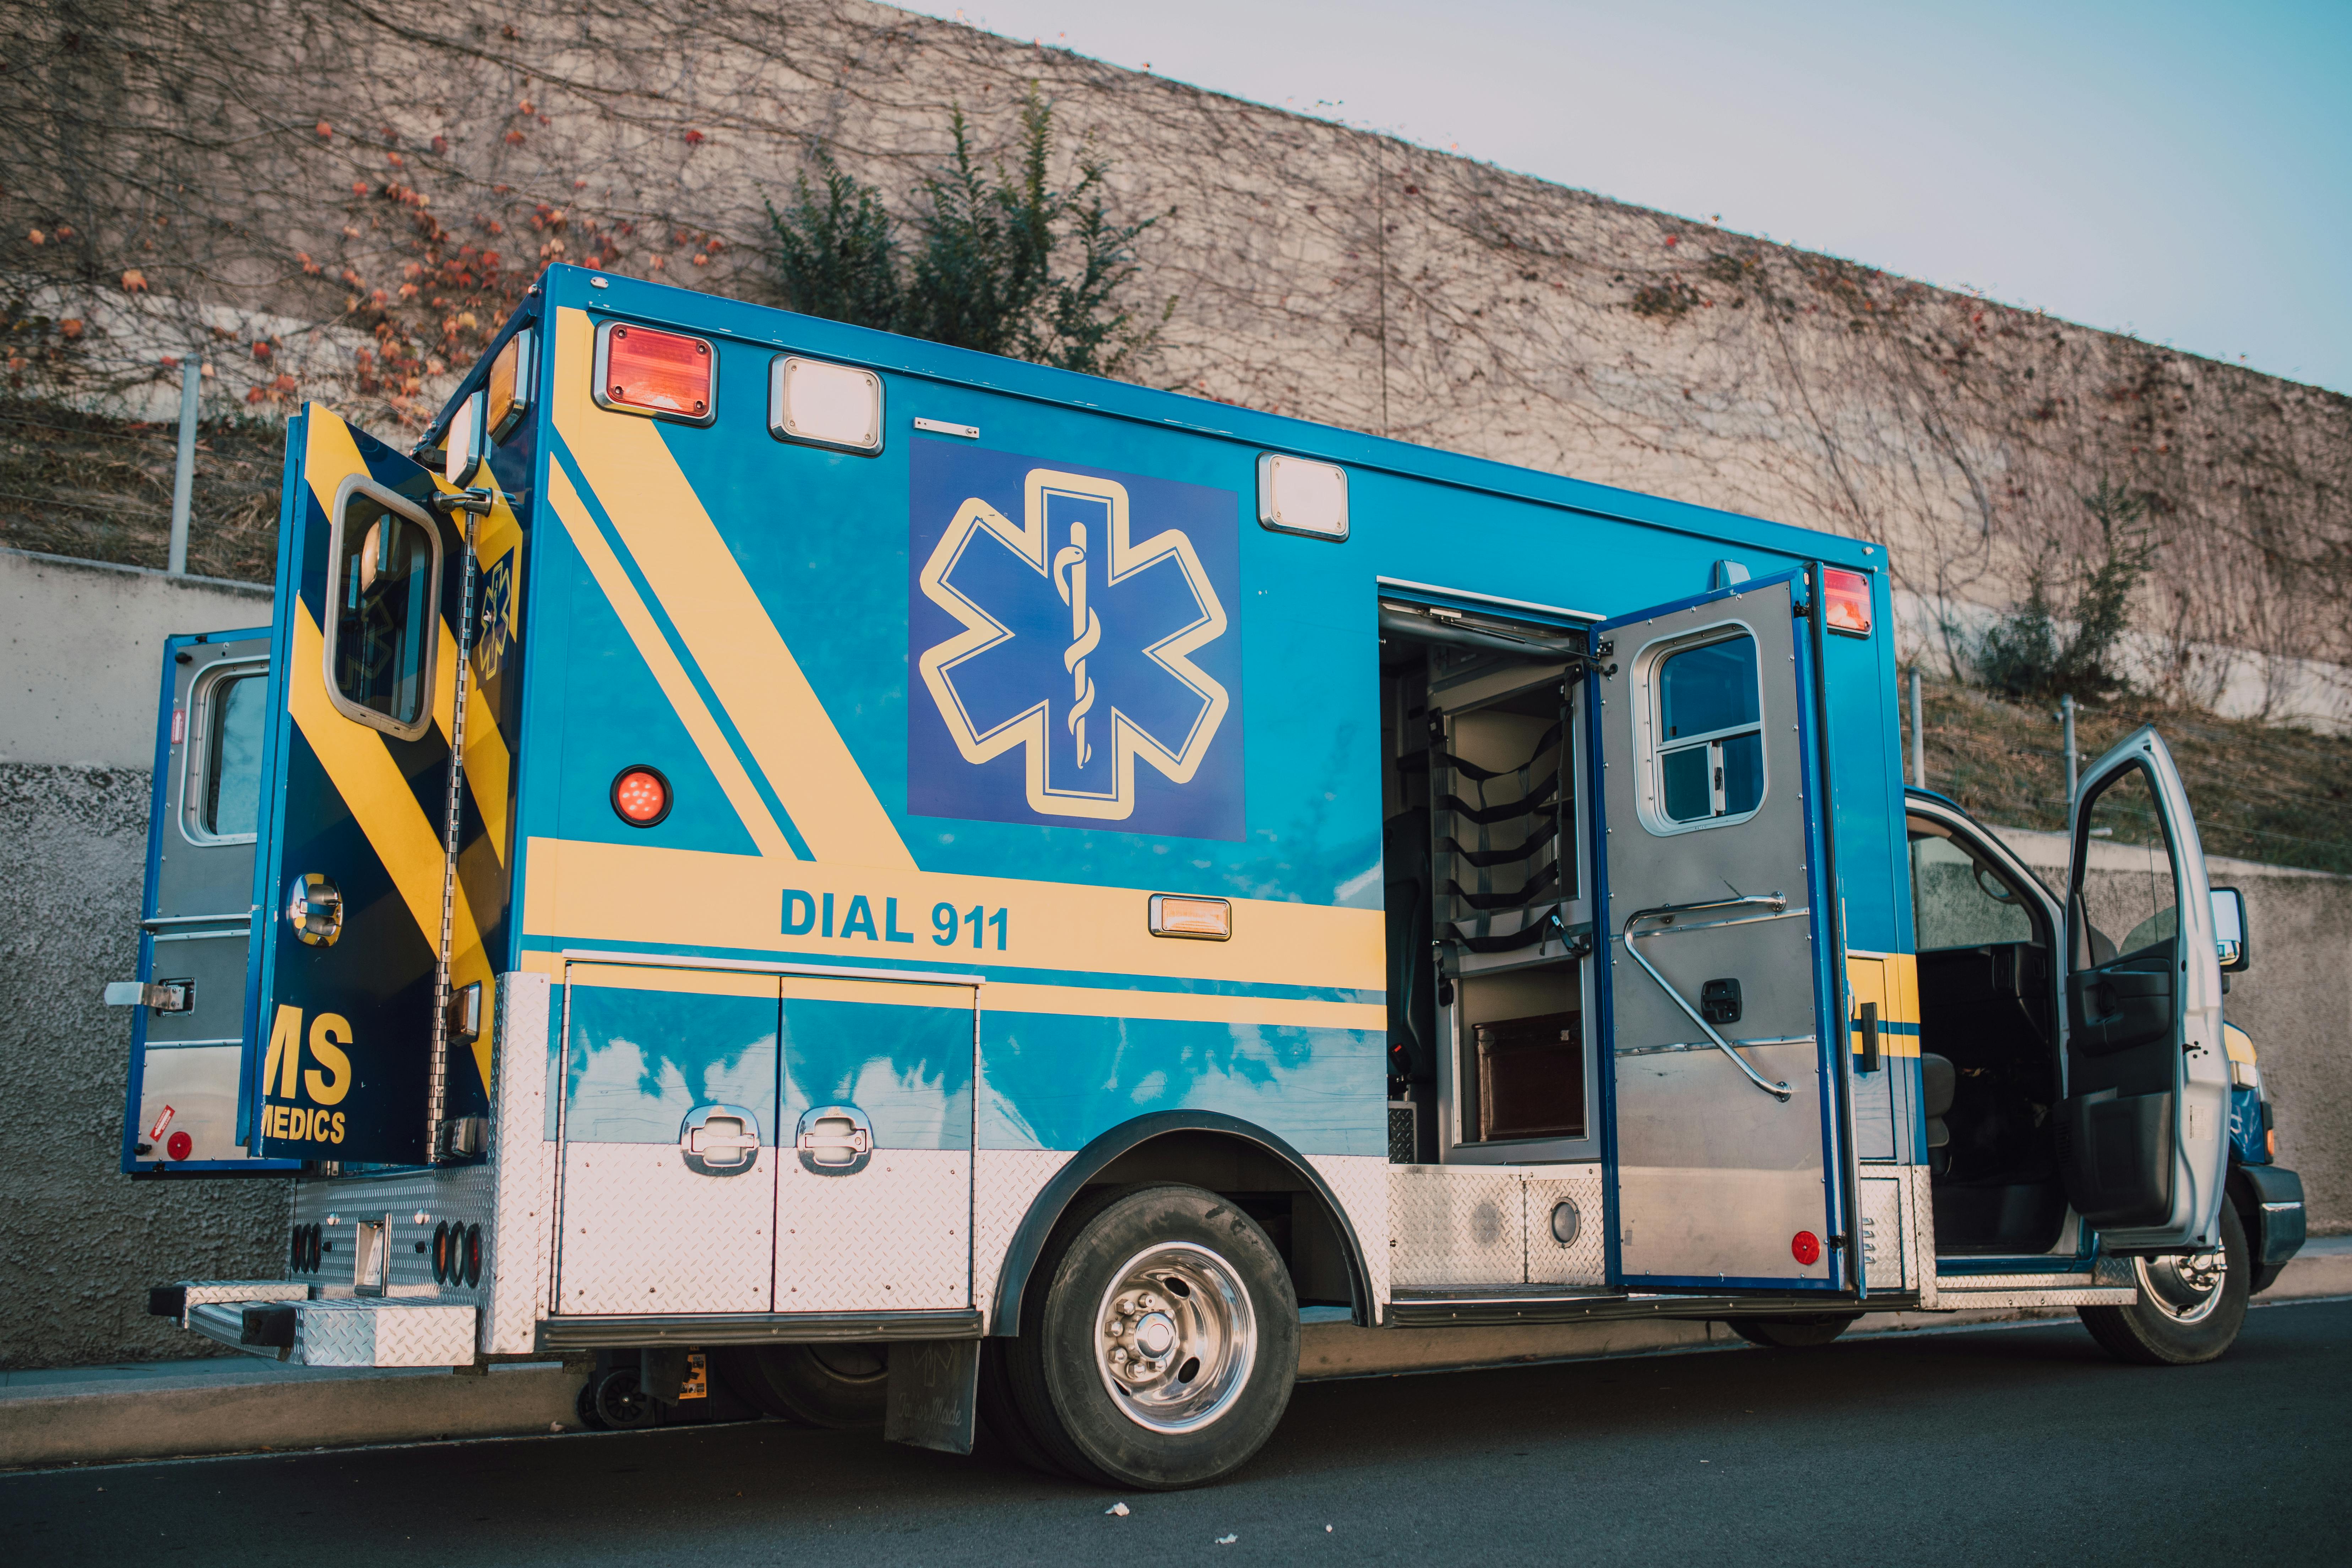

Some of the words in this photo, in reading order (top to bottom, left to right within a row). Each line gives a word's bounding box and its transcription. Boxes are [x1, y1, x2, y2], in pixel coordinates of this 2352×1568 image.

[781, 889, 914, 944] DIAL
[931, 902, 1008, 951] 911
[930, 1396, 962, 1427] Made
